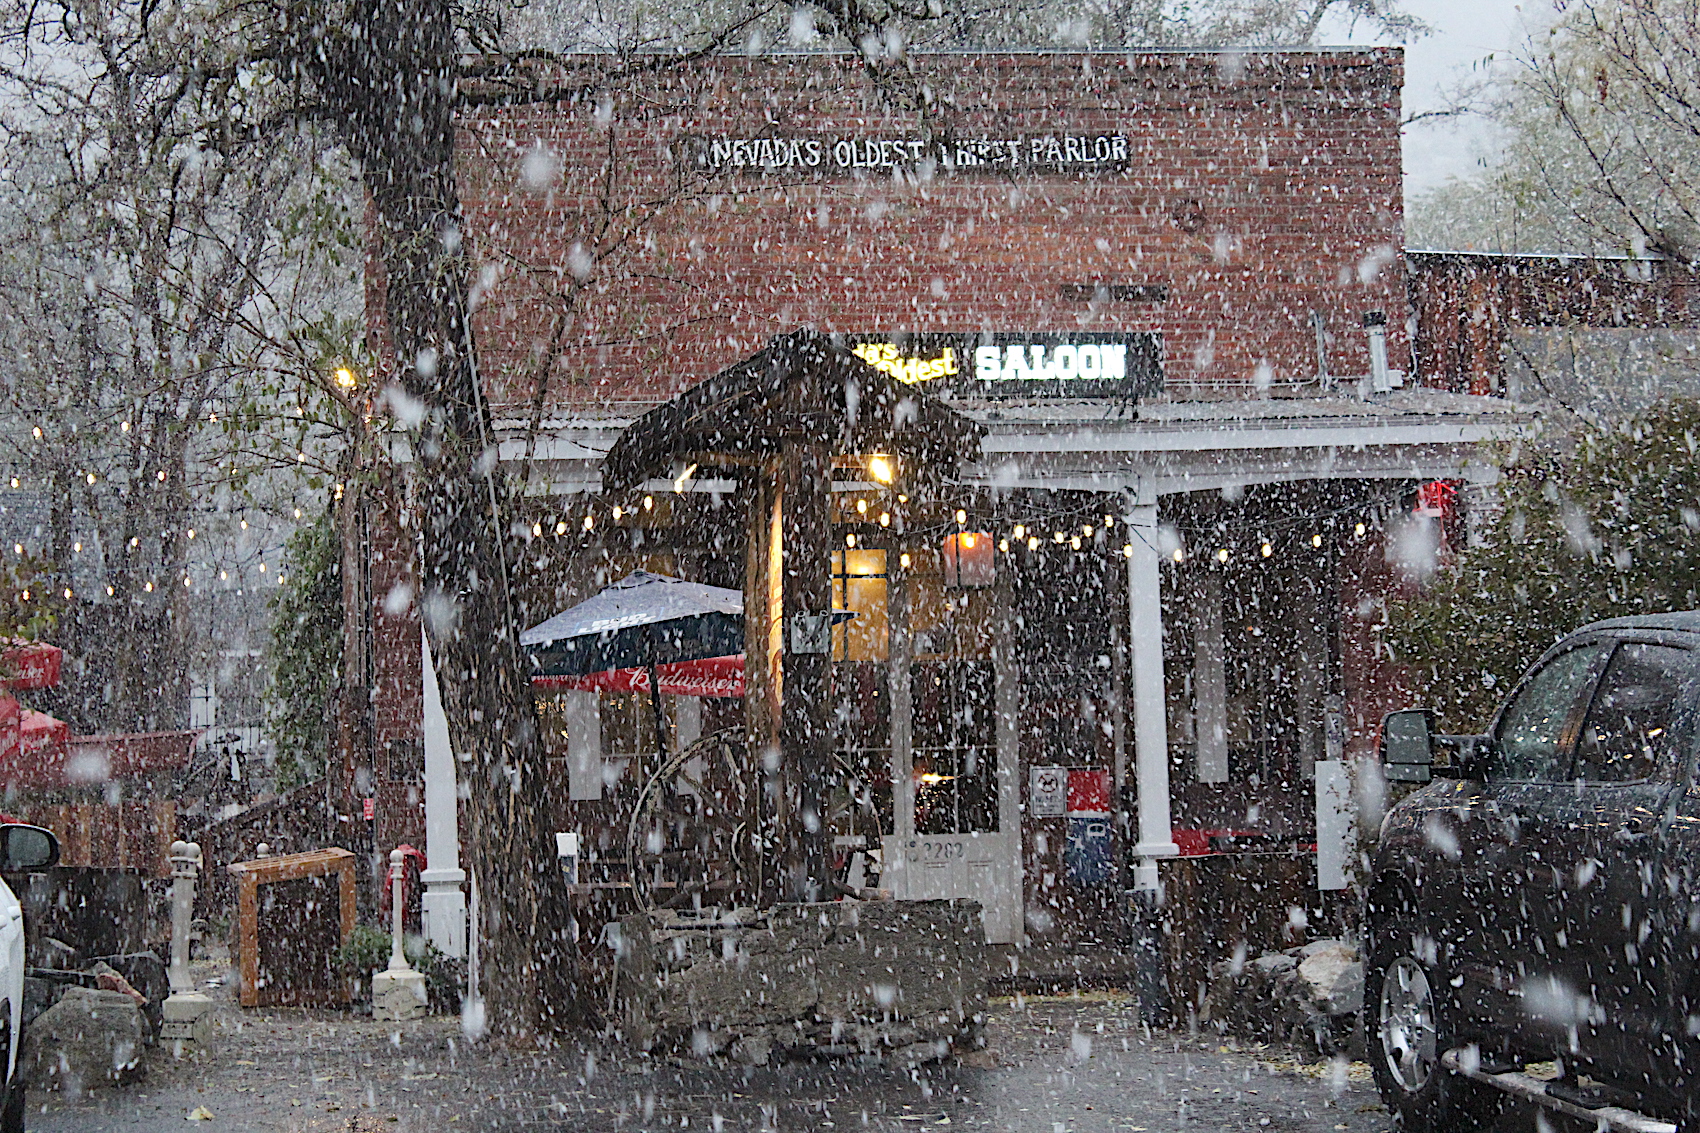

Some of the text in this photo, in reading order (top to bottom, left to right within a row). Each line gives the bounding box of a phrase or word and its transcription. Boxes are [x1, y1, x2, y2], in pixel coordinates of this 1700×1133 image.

[711, 138, 821, 168] NEVADA'S
[835, 140, 925, 167] OLDEST
[1030, 136, 1128, 163] PARLOR
[975, 343, 1127, 381] SALOON
